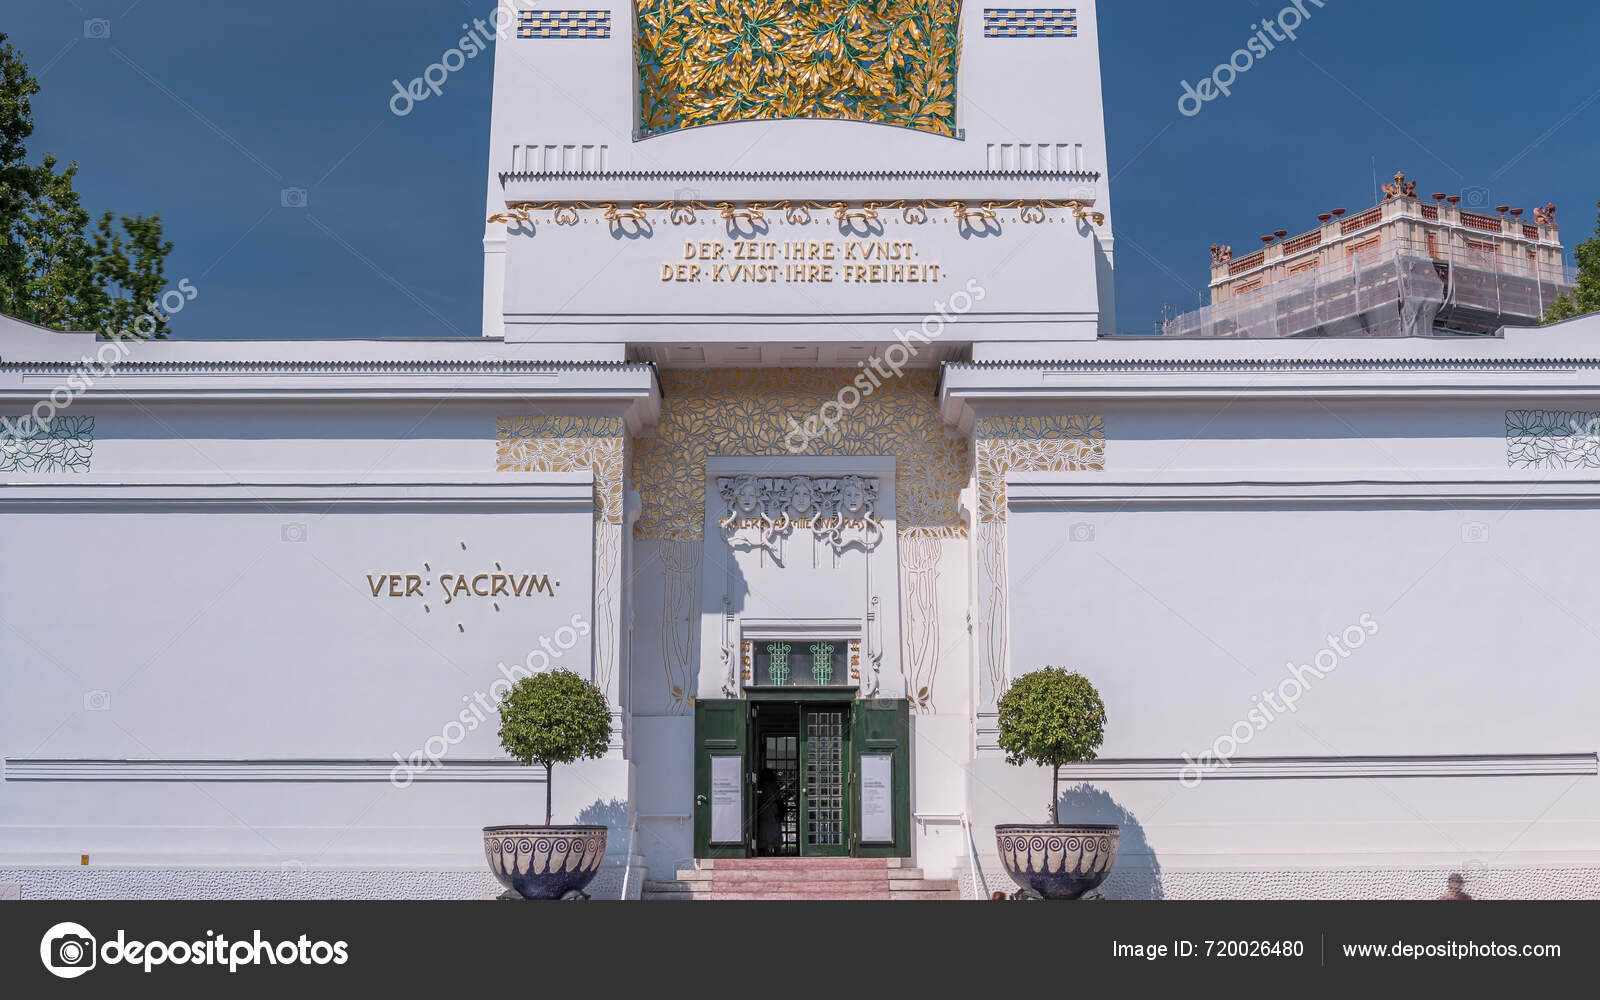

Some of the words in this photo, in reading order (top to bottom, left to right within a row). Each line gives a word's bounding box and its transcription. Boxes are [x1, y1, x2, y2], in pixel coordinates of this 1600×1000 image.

[683, 241, 724, 260] DER
[733, 241, 777, 260] ZEIT
[783, 241, 835, 260] IHRE
[660, 262, 701, 282] DER
[785, 263, 833, 282] IHRE
